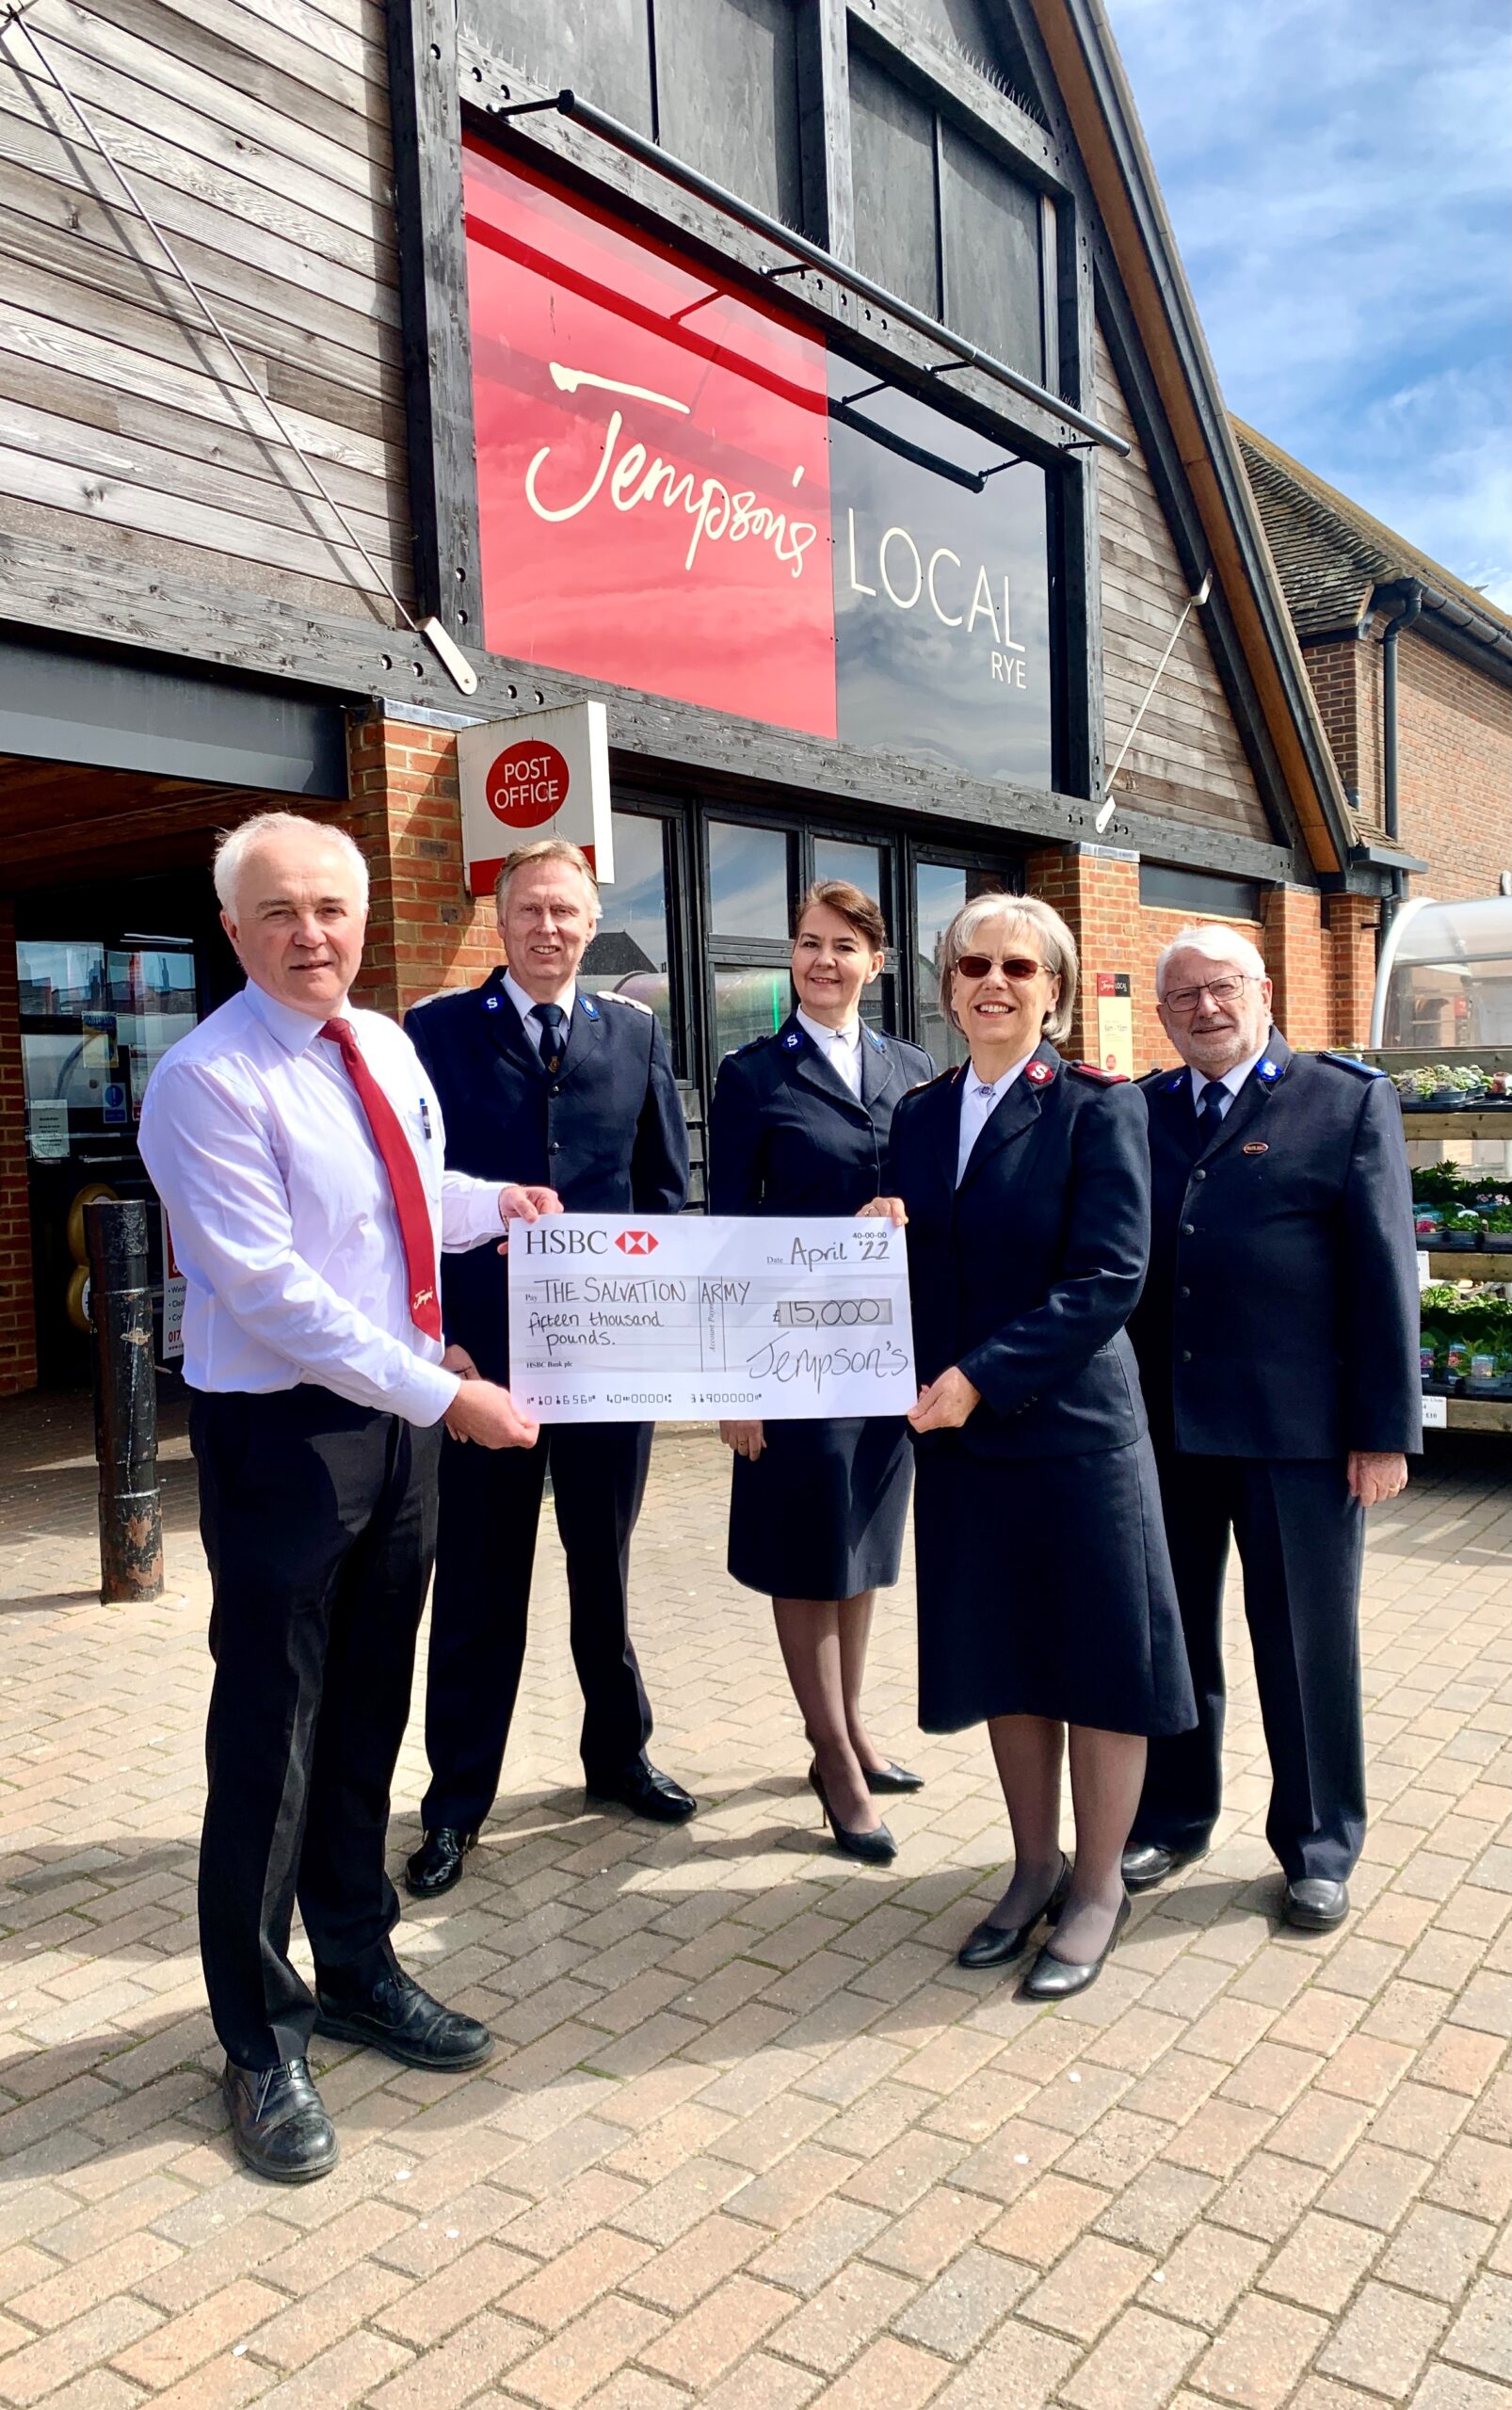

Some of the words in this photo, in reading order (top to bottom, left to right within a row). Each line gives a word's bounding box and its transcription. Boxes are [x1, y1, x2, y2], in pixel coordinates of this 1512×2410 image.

[524, 362, 817, 579] Jempson's
[848, 507, 1025, 653] LOCAL
[991, 651, 1027, 689] RYE
[504, 756, 551, 784] POST
[494, 779, 559, 810] OFFICE
[526, 1229, 608, 1255] HSBC
[791, 1237, 847, 1272] April
[525, 1293, 538, 1303] Pay
[534, 1278, 580, 1303] THE
[584, 1277, 686, 1303] SALVATION
[701, 1281, 750, 1306] ARMY
[528, 1311, 579, 1336] fifteen
[589, 1311, 665, 1327] thousand
[789, 1298, 880, 1330] 15,000
[564, 1360, 573, 1369] plc
[747, 1331, 909, 1394] Jempson's
